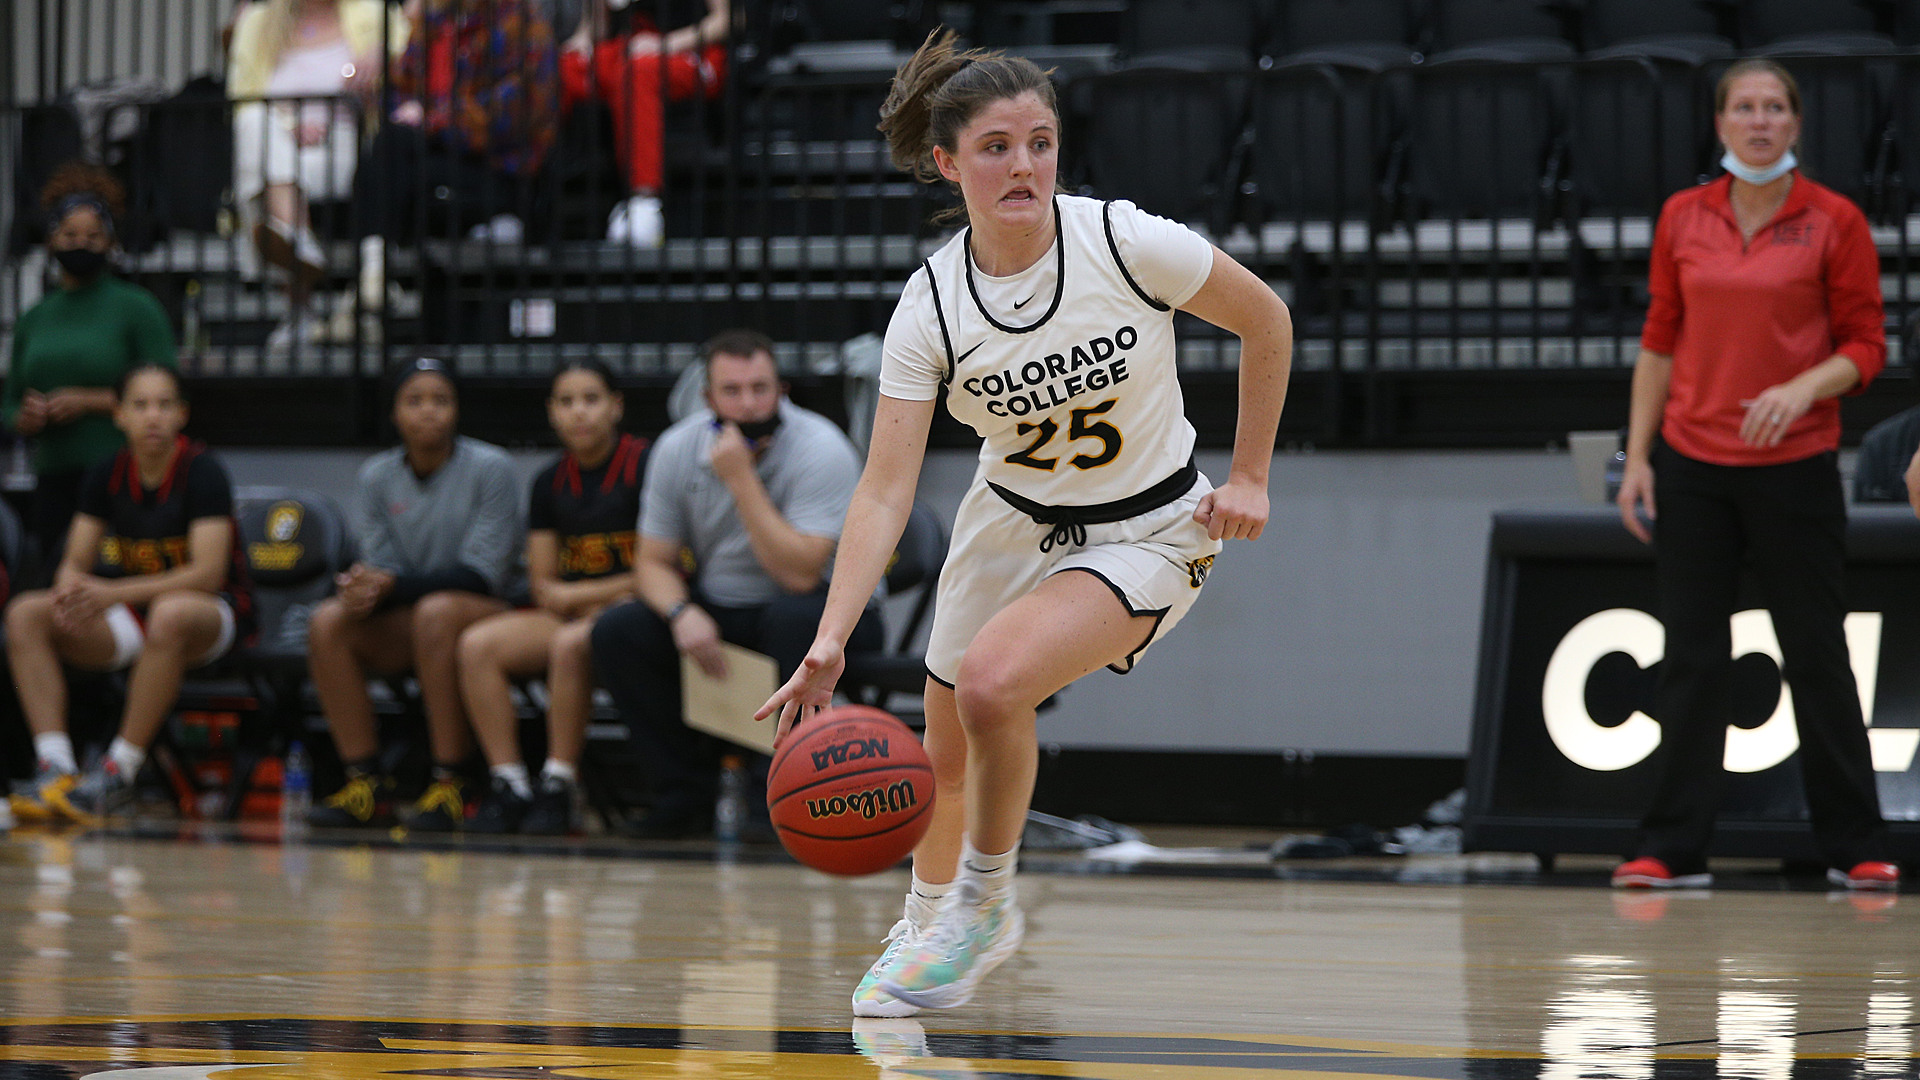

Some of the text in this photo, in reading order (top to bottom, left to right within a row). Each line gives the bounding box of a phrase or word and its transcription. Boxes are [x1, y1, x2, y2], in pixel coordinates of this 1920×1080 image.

[963, 326, 1138, 397] COLORADO
[987, 357, 1130, 417] COLLEGE
[1004, 397, 1124, 473] 25
[811, 737, 889, 772] NCAA
[806, 778, 918, 820] Wilson
